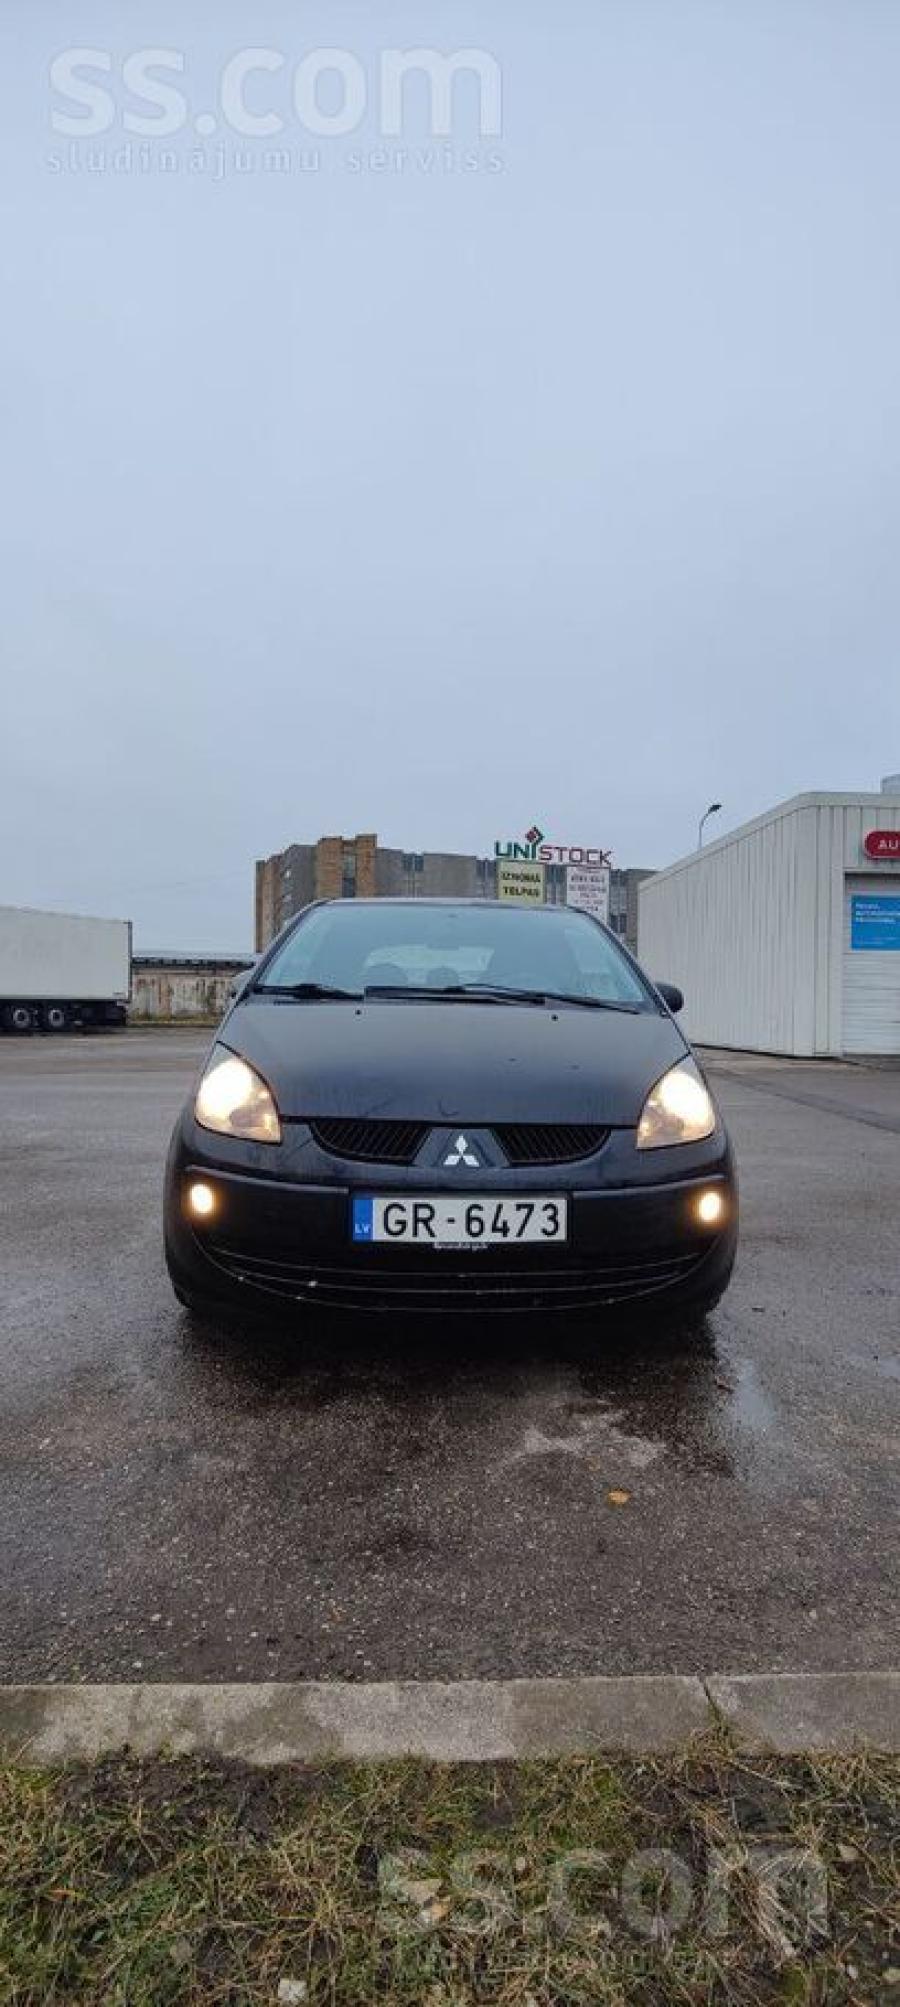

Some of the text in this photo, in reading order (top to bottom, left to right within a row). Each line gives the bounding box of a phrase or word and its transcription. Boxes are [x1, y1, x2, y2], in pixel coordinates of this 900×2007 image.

[879, 839, 898, 849] AU
[494, 841, 613, 865] UNISTOCK
[354, 1223, 371, 1235] LV
